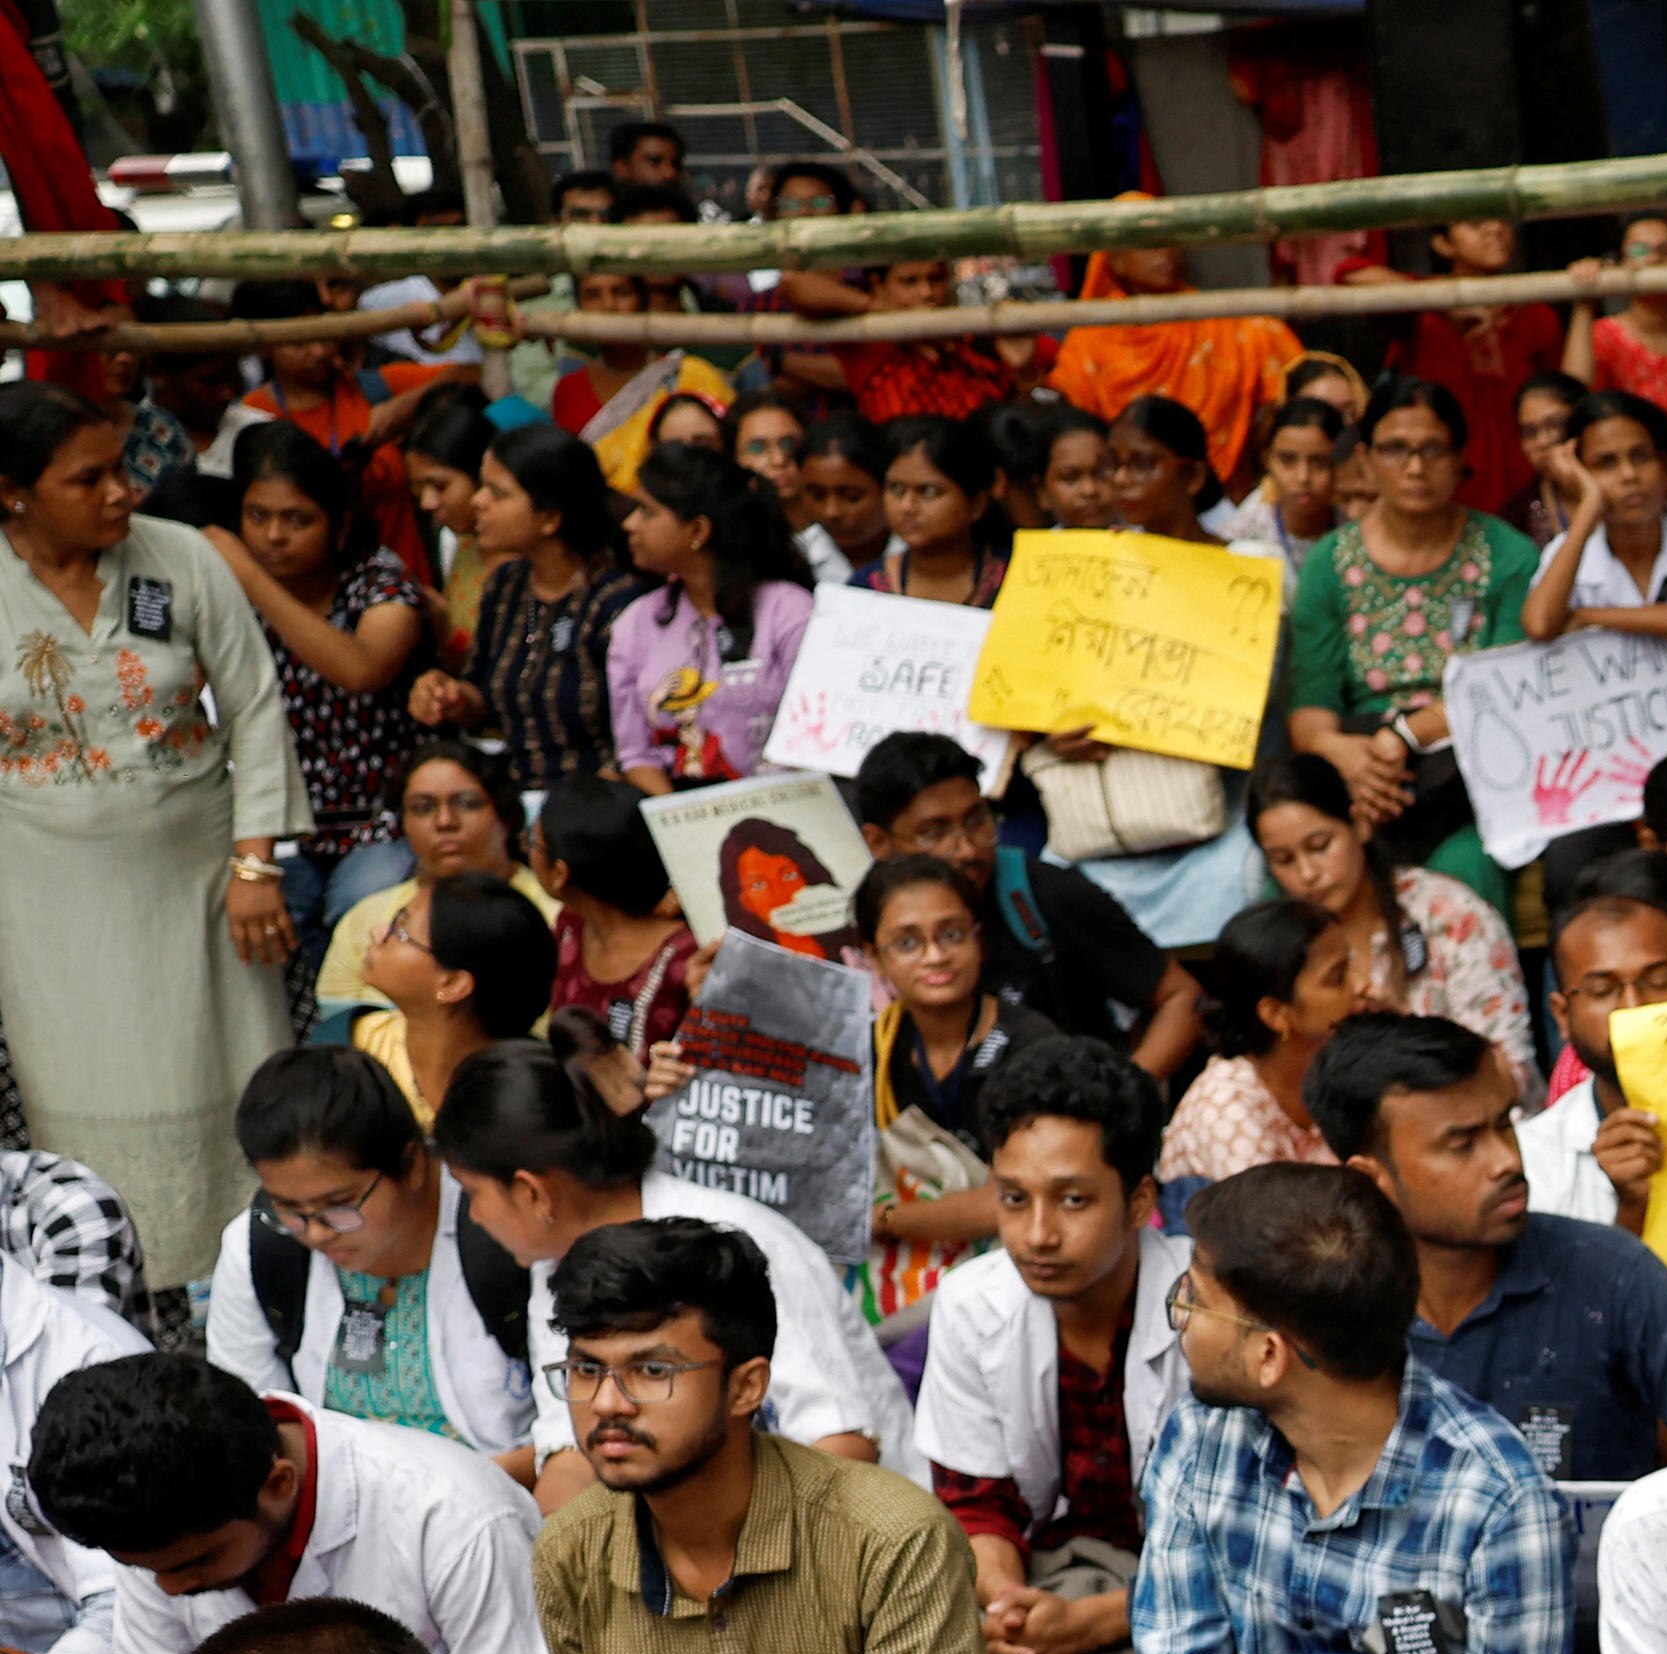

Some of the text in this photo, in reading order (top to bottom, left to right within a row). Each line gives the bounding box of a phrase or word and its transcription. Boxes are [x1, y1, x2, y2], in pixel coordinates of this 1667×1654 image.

[857, 657, 955, 699] SAFE
[1491, 645, 1573, 711] WE
[677, 1079, 815, 1135] JUSTICE
[672, 1118, 740, 1164] FOR
[672, 1159, 789, 1205] VICTIM
